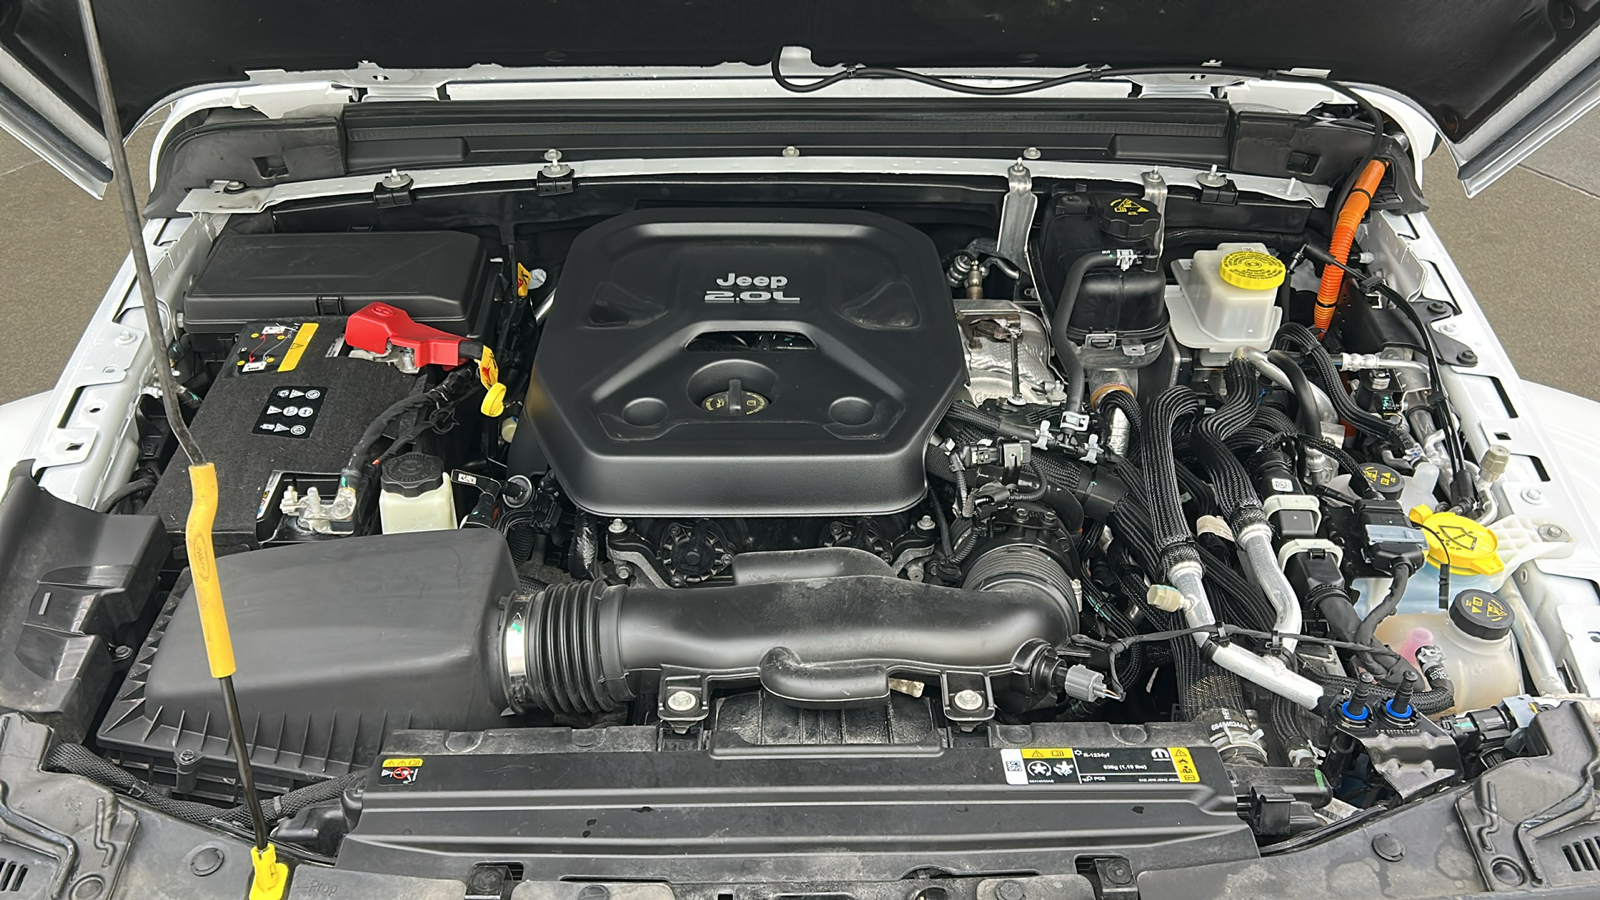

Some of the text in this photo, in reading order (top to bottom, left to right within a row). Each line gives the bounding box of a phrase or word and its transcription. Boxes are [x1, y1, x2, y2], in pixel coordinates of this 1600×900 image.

[716, 272, 789, 289] Jeep
[704, 290, 801, 304] 2.0L
[308, 879, 339, 897] Prop
